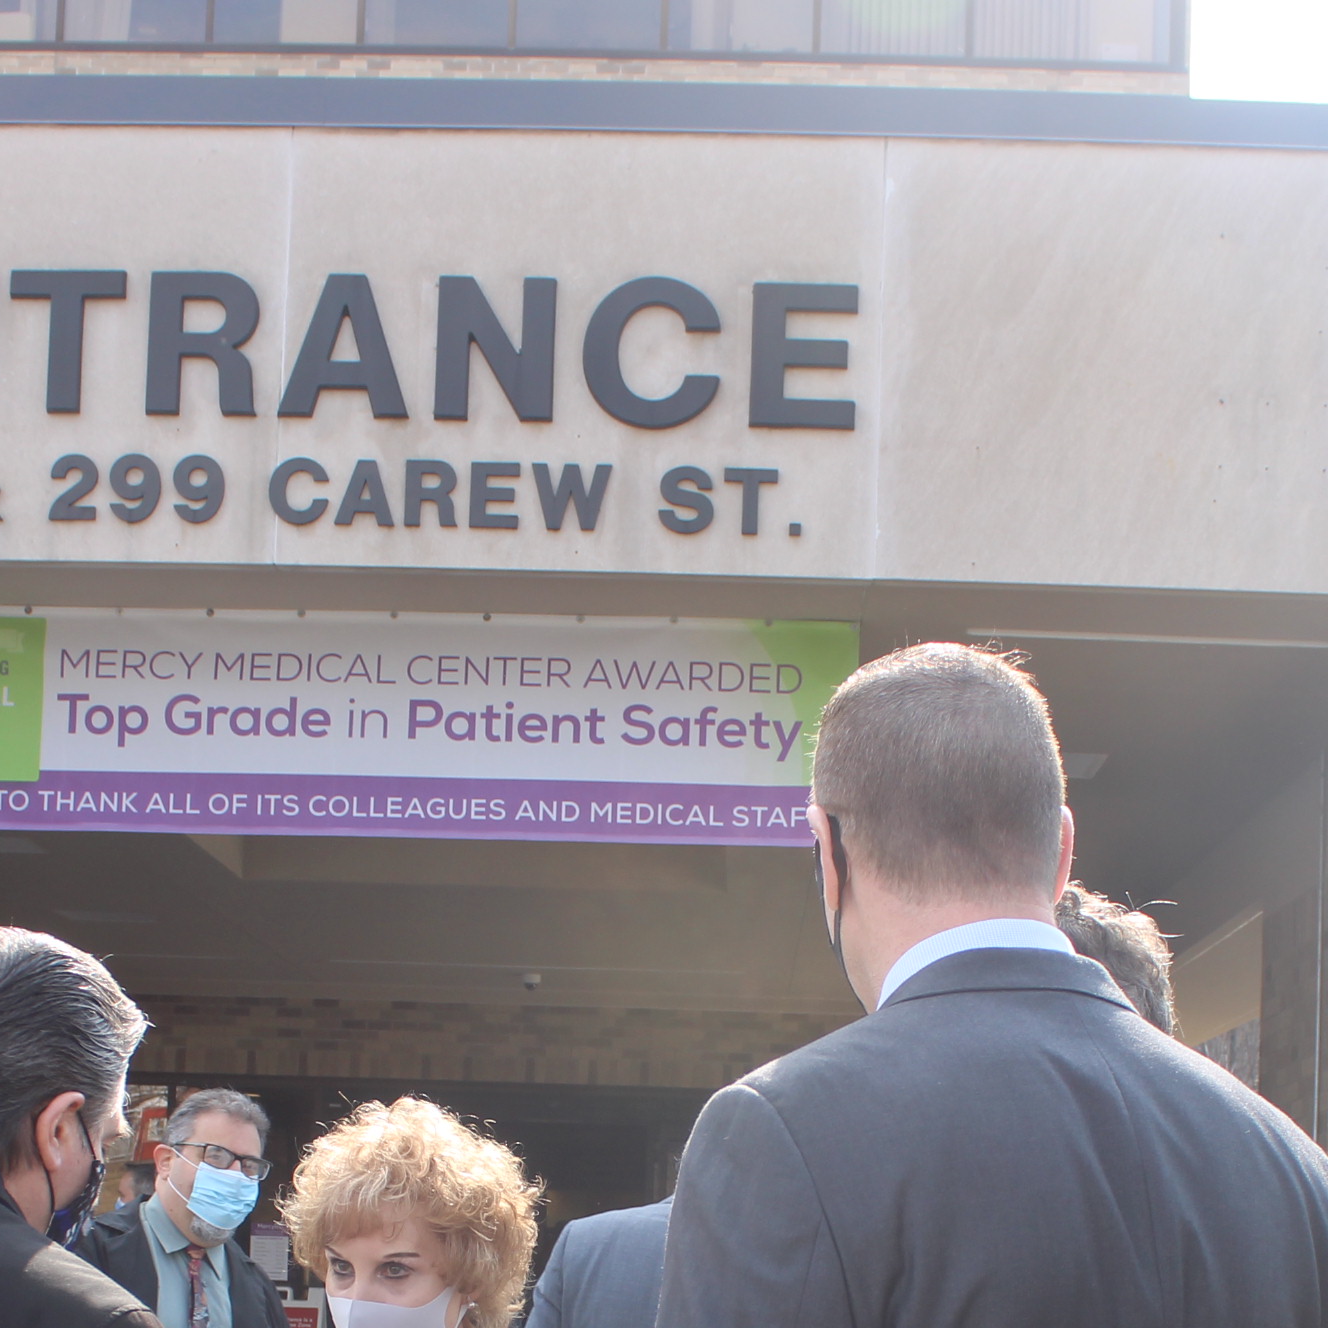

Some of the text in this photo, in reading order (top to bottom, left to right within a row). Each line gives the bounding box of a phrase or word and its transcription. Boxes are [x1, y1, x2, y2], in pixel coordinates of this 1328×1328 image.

[49, 453, 225, 524] 299
[269, 456, 612, 531] CAREW
[658, 465, 801, 536] ST.
[59, 648, 803, 694] MERCY MEDICAL CENTER AWARDED
[57, 693, 803, 762] Top Grade in Patient Safety
[38, 790, 138, 813] THANK
[146, 792, 200, 814] ALL
[208, 793, 248, 815] OF
[257, 794, 300, 816] ITS
[308, 795, 506, 820] COLLEAGUES
[515, 799, 580, 822] AND
[590, 802, 724, 826] MEDICAL
[732, 805, 808, 828] STAF
